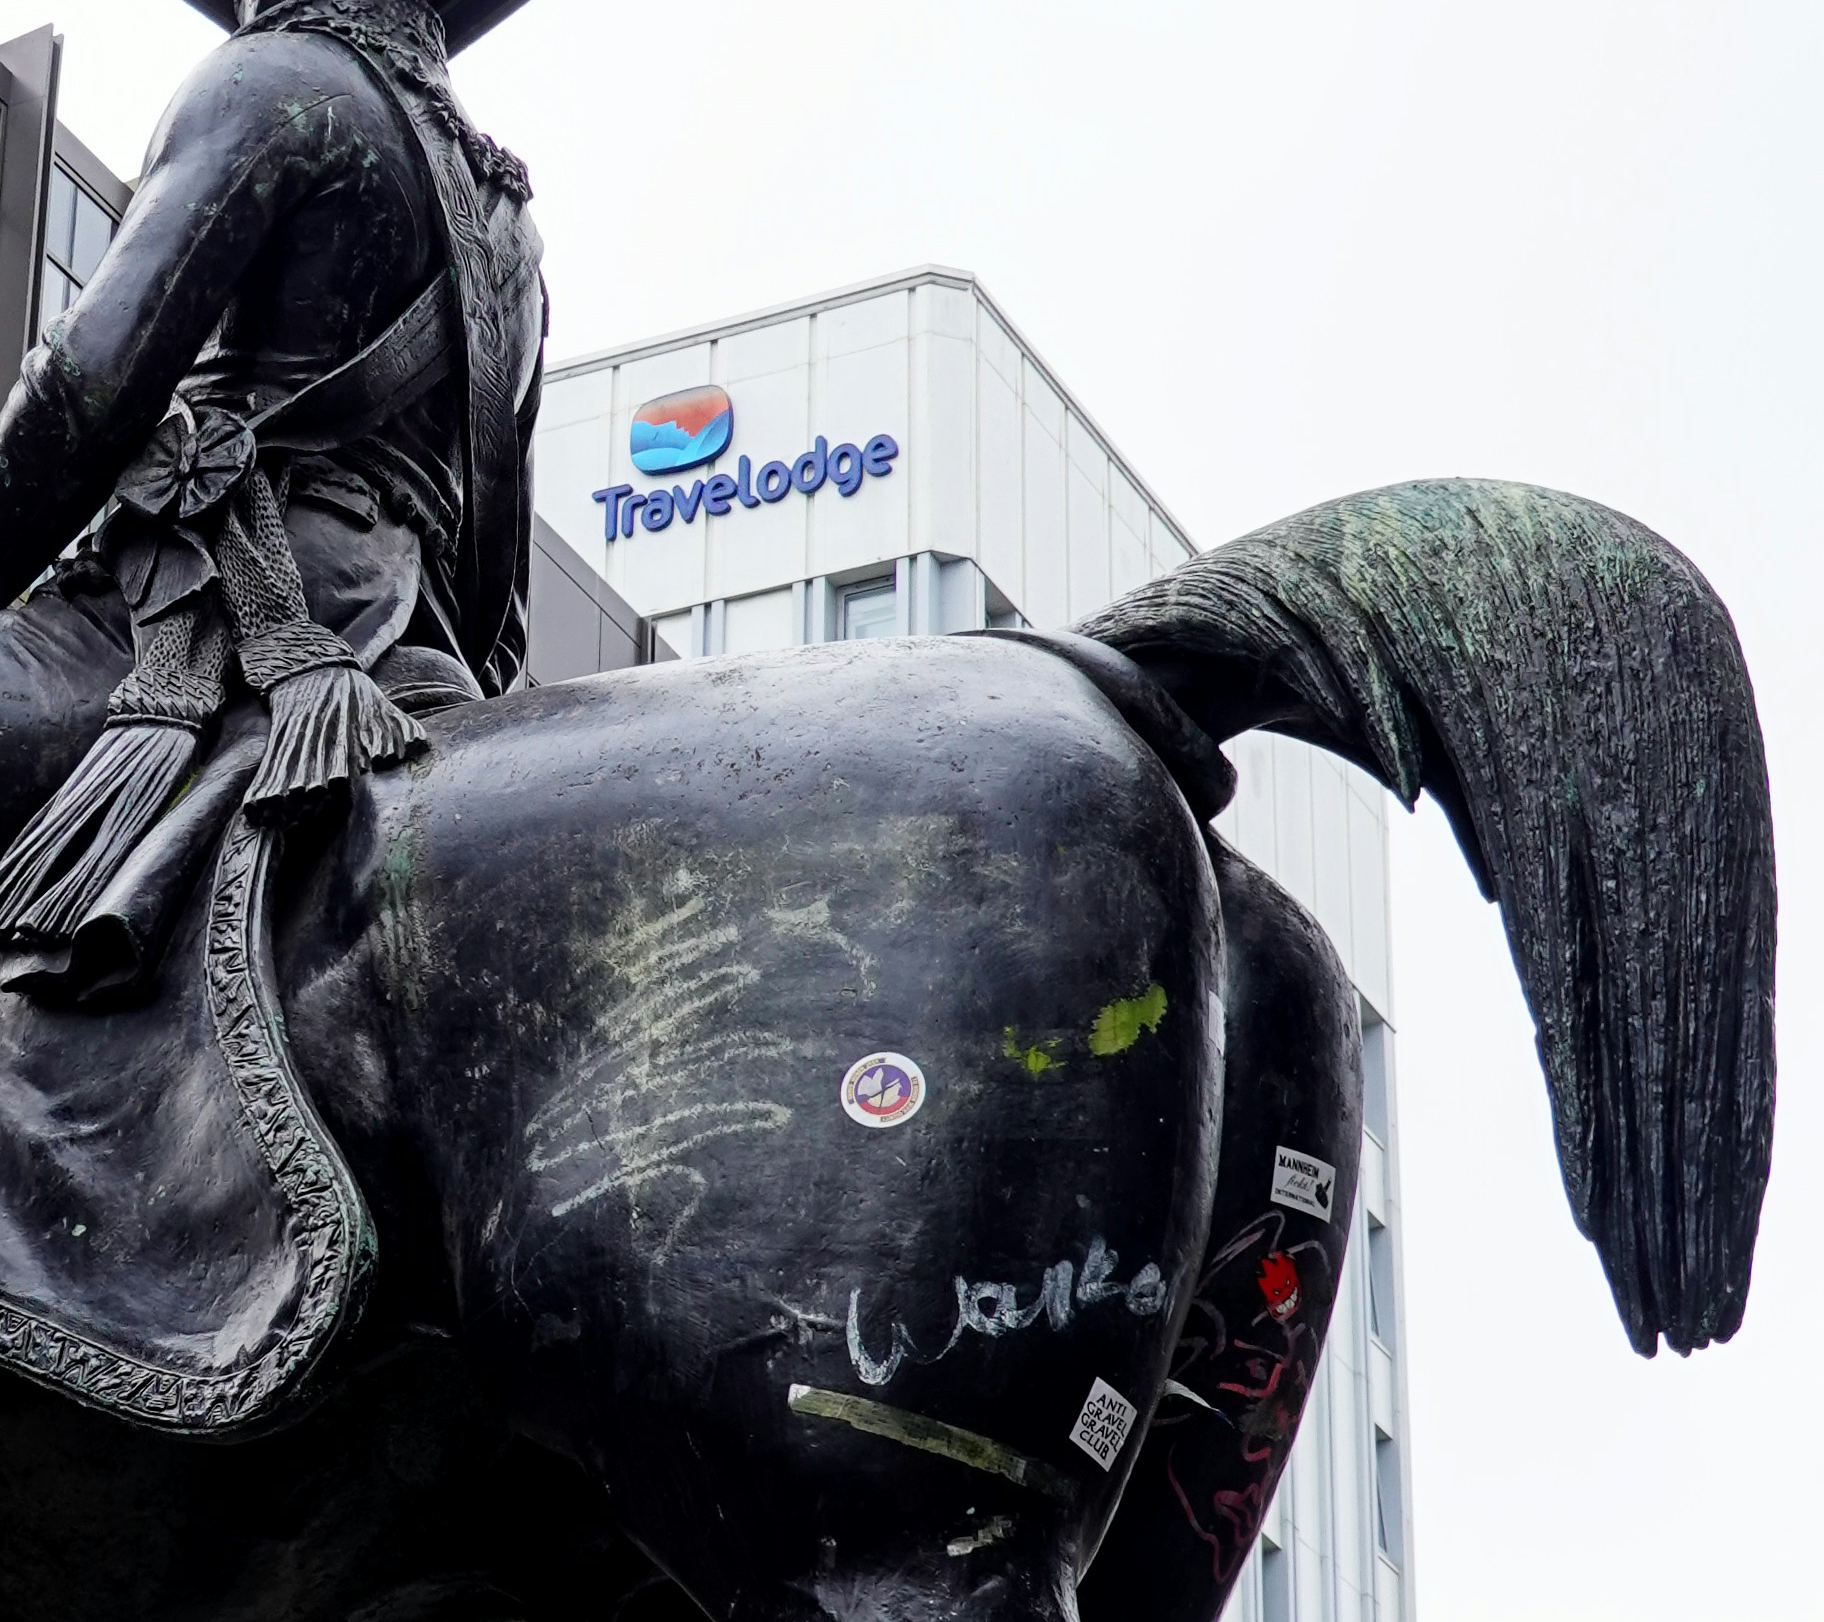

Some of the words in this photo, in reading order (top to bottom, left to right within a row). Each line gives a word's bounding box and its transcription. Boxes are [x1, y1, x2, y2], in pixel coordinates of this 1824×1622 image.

[592, 434, 899, 542] Travelodge
[1278, 1154, 1320, 1180] MANNHEIM
[1087, 1401, 1126, 1437] GRAVEL
[1096, 1393, 1127, 1417] ANTI
[1080, 1430, 1109, 1460] CLUB
[1081, 1413, 1118, 1452] GRAVEL
